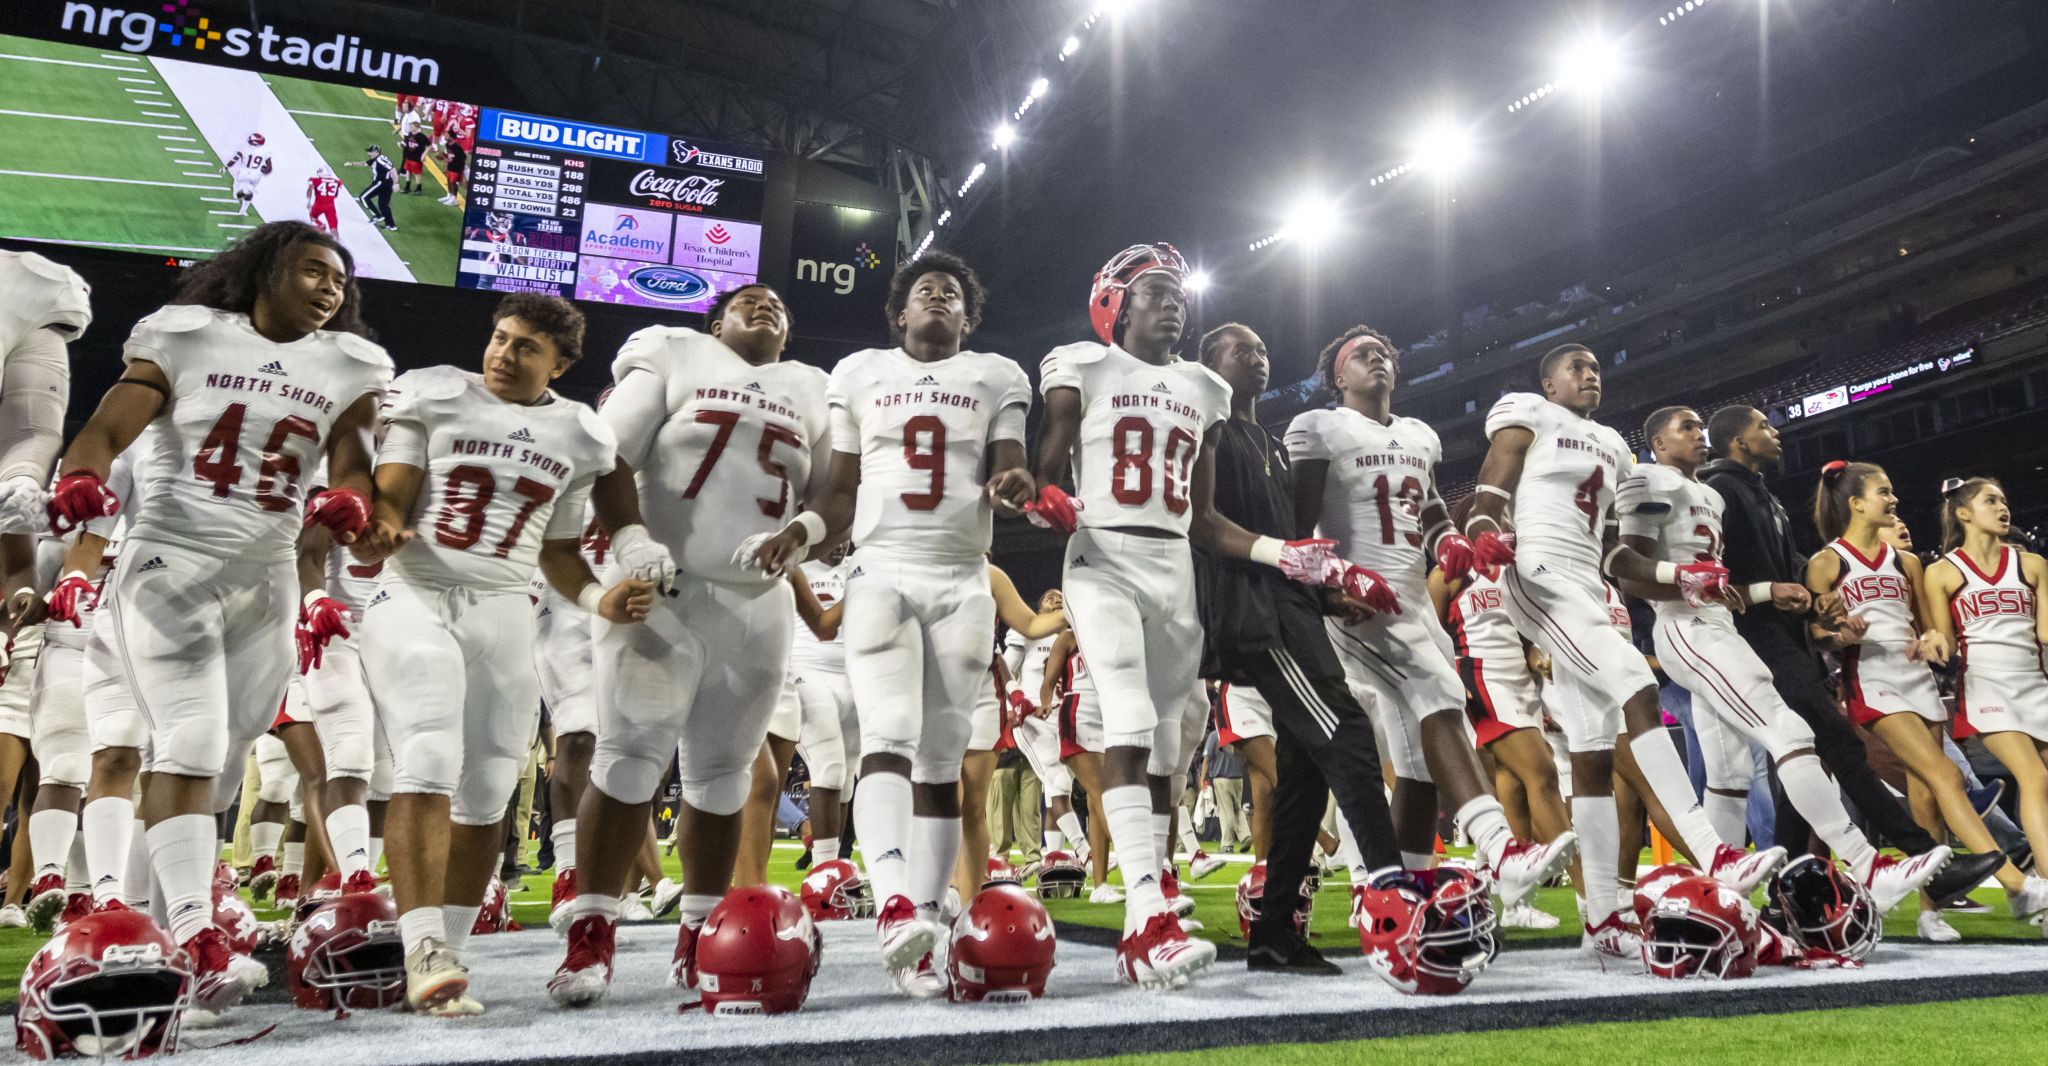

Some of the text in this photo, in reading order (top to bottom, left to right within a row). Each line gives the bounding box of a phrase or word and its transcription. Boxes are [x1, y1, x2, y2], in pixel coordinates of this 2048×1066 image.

[61, 1, 441, 86] nrg stadium
[501, 118, 641, 155] BUD LIGHT
[246, 154, 263, 170] 19
[476, 159, 584, 180] 159 RUSH YDS 188
[564, 159, 585, 168] KHS
[697, 153, 763, 172] TEXANS RADIO
[317, 181, 338, 197] 43
[475, 172, 582, 193] 341 PASS YDS 298
[629, 169, 725, 206] Coca-Cola
[472, 184, 581, 205] 500 TOTAL YDS 486
[475, 197, 489, 206] 15
[520, 204, 552, 213] DOWNS
[562, 208, 576, 217] 23
[648, 199, 703, 213] zero SUGAR
[495, 245, 564, 260] SEASON TICKET
[585, 230, 664, 255] Academy
[683, 242, 751, 259] Texas Children's
[527, 257, 572, 270] PRIORITY
[696, 255, 733, 267] Hospital
[497, 263, 565, 281] WAIT LIST
[647, 271, 689, 292] Ford
[796, 258, 856, 295] nrg
[1849, 381, 1873, 394] Charge
[1872, 377, 1887, 389] your
[1887, 369, 1909, 383] phone
[1908, 366, 1919, 375] for
[1918, 361, 1934, 371] free
[206, 373, 334, 415] NORTH SHORE
[696, 388, 751, 404] NORTH
[875, 391, 980, 412] NORTH SHORE
[1112, 395, 1159, 408] NORTH
[1788, 404, 1802, 419] 38
[193, 401, 322, 513] 46
[452, 439, 570, 480] NORTH SHORE
[682, 409, 801, 519] 75
[900, 415, 946, 512] 9
[1111, 416, 1197, 517] 80
[1355, 454, 1395, 468] NORTH
[1575, 464, 1605, 535] 4
[435, 464, 556, 560] 87
[1842, 576, 1911, 610] NSSH
[1958, 589, 2035, 623] NSSH
[751, 978, 762, 992] 75
